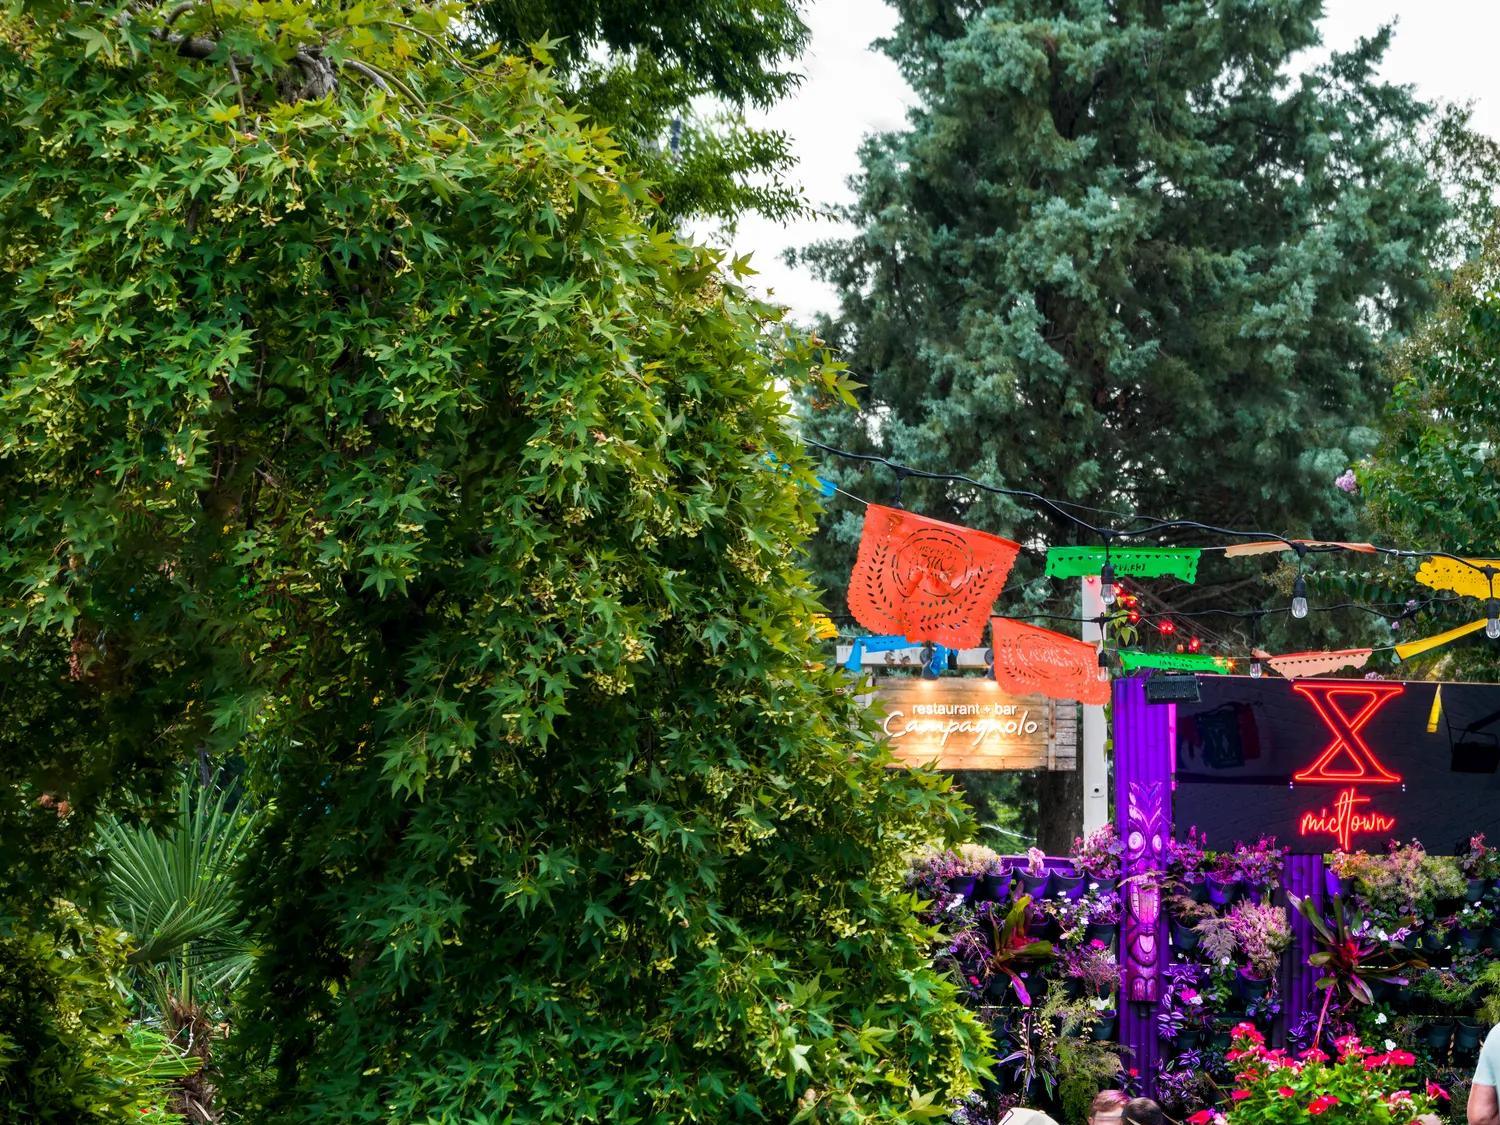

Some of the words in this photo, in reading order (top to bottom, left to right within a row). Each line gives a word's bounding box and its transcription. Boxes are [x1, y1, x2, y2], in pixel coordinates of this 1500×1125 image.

[912, 703, 980, 716] restaurant
[995, 703, 1017, 716] bar
[883, 710, 1038, 746] Campagnolo
[1300, 787, 1396, 851] midtown
